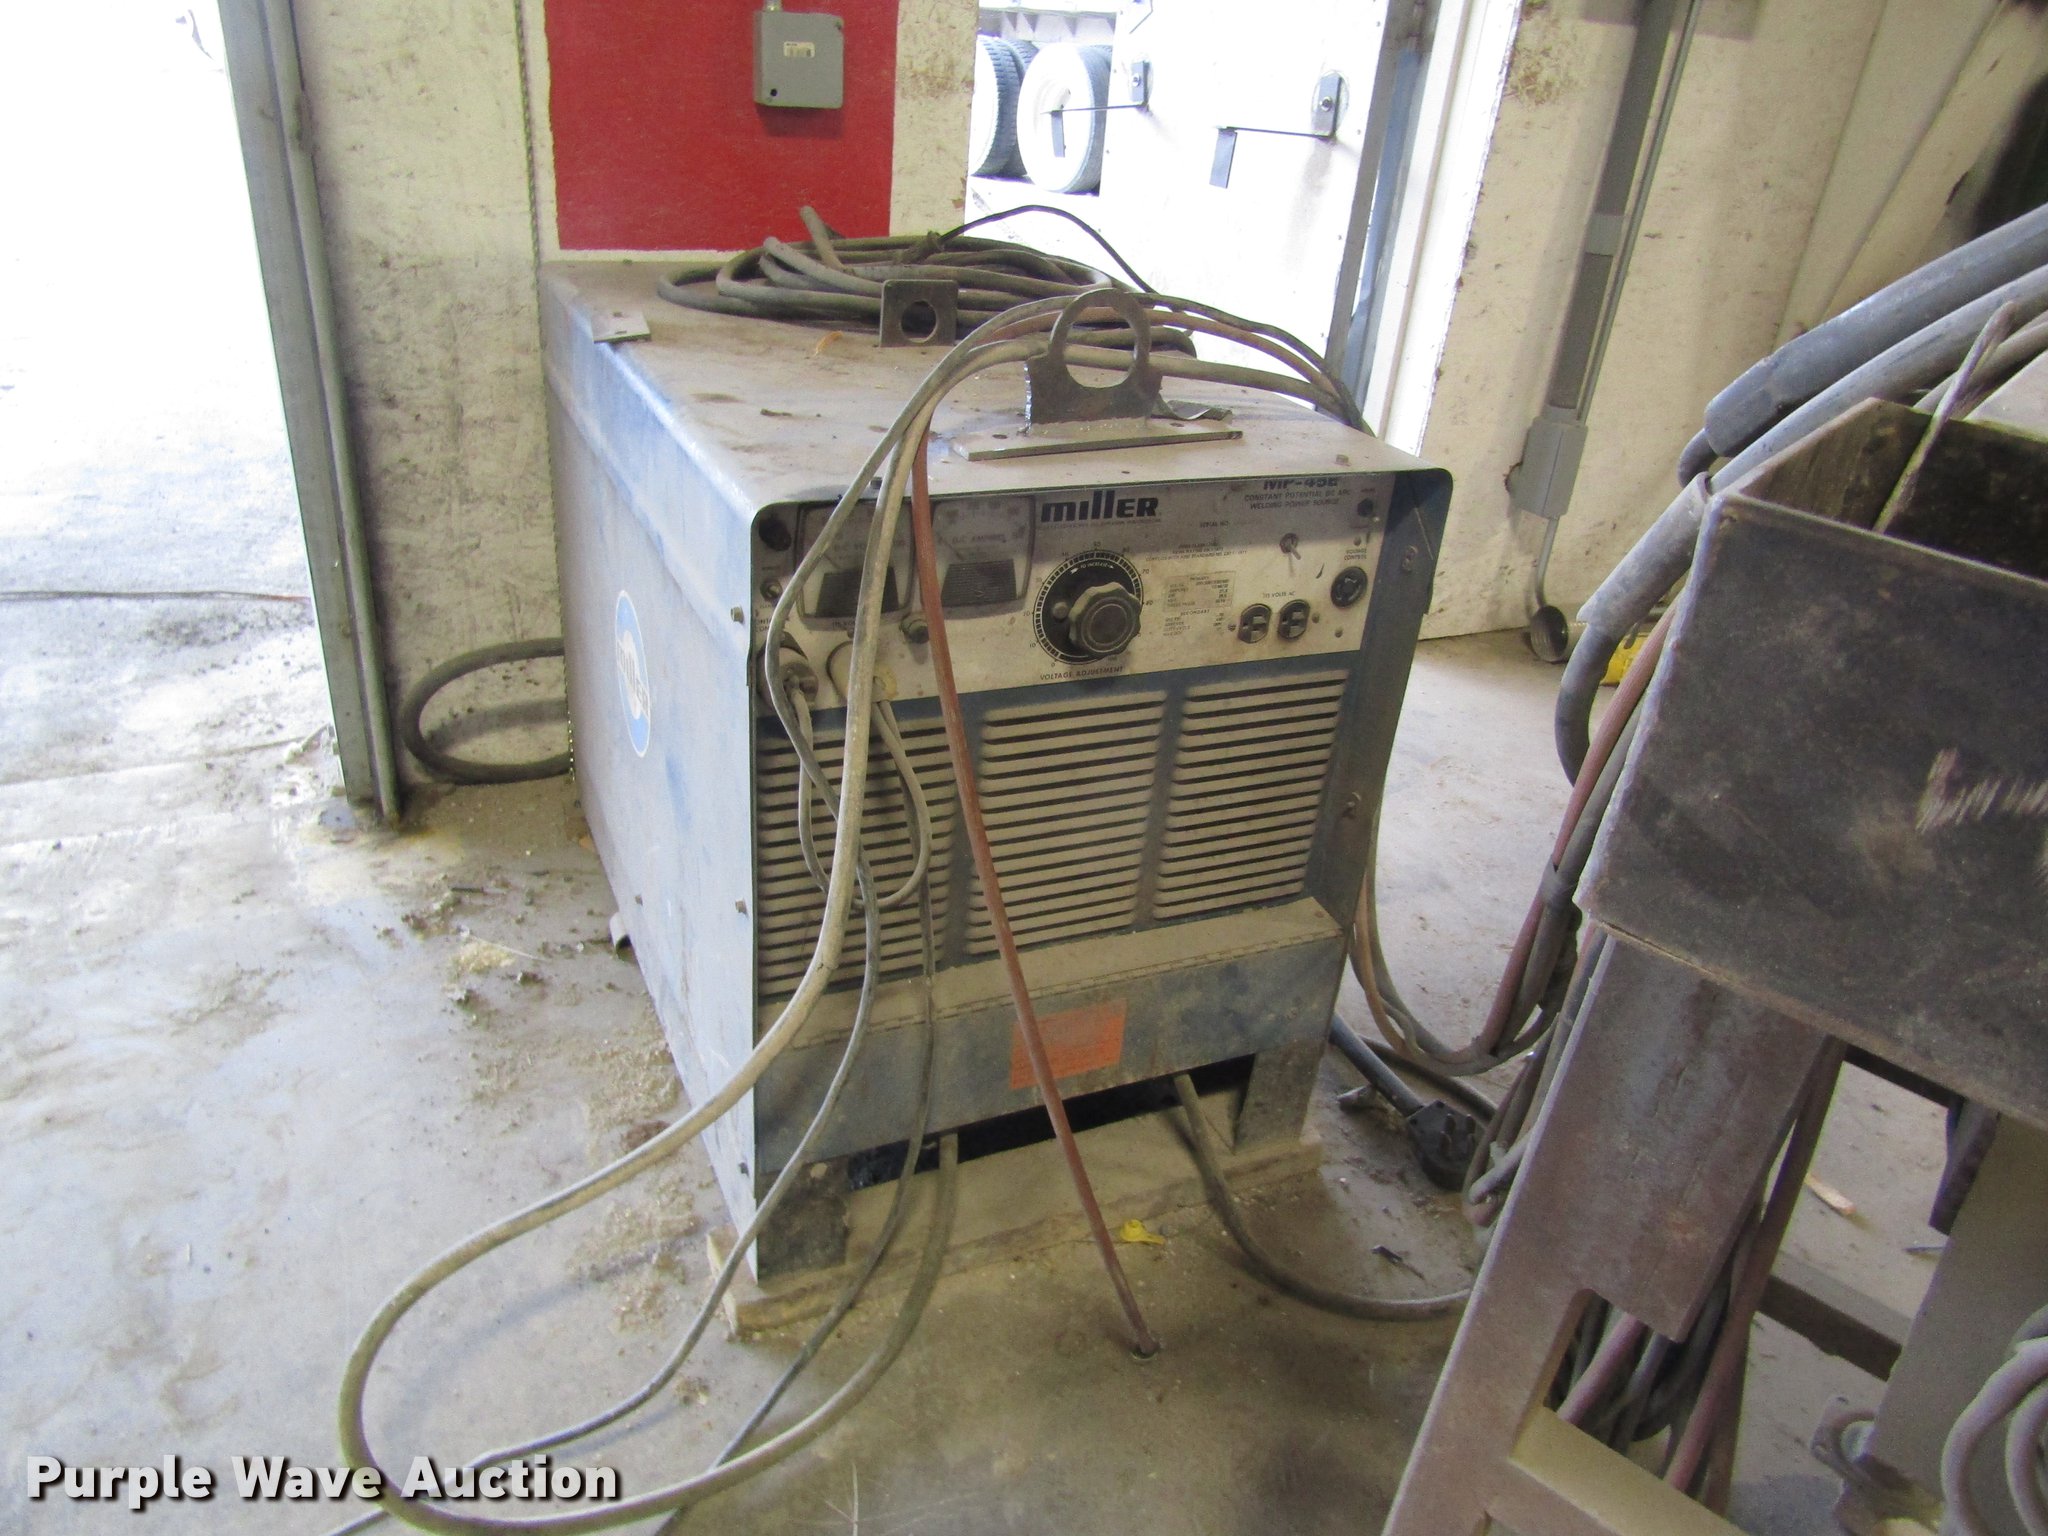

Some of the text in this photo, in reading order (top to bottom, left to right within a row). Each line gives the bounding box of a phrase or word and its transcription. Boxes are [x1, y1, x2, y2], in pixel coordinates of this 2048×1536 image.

[1244, 493, 1282, 502] CONSTANT
[1285, 490, 1320, 499] POTENTIAL
[1250, 500, 1282, 510] WELDING
[1040, 665, 1124, 681] VOLTAGE ADJUSTMENT
